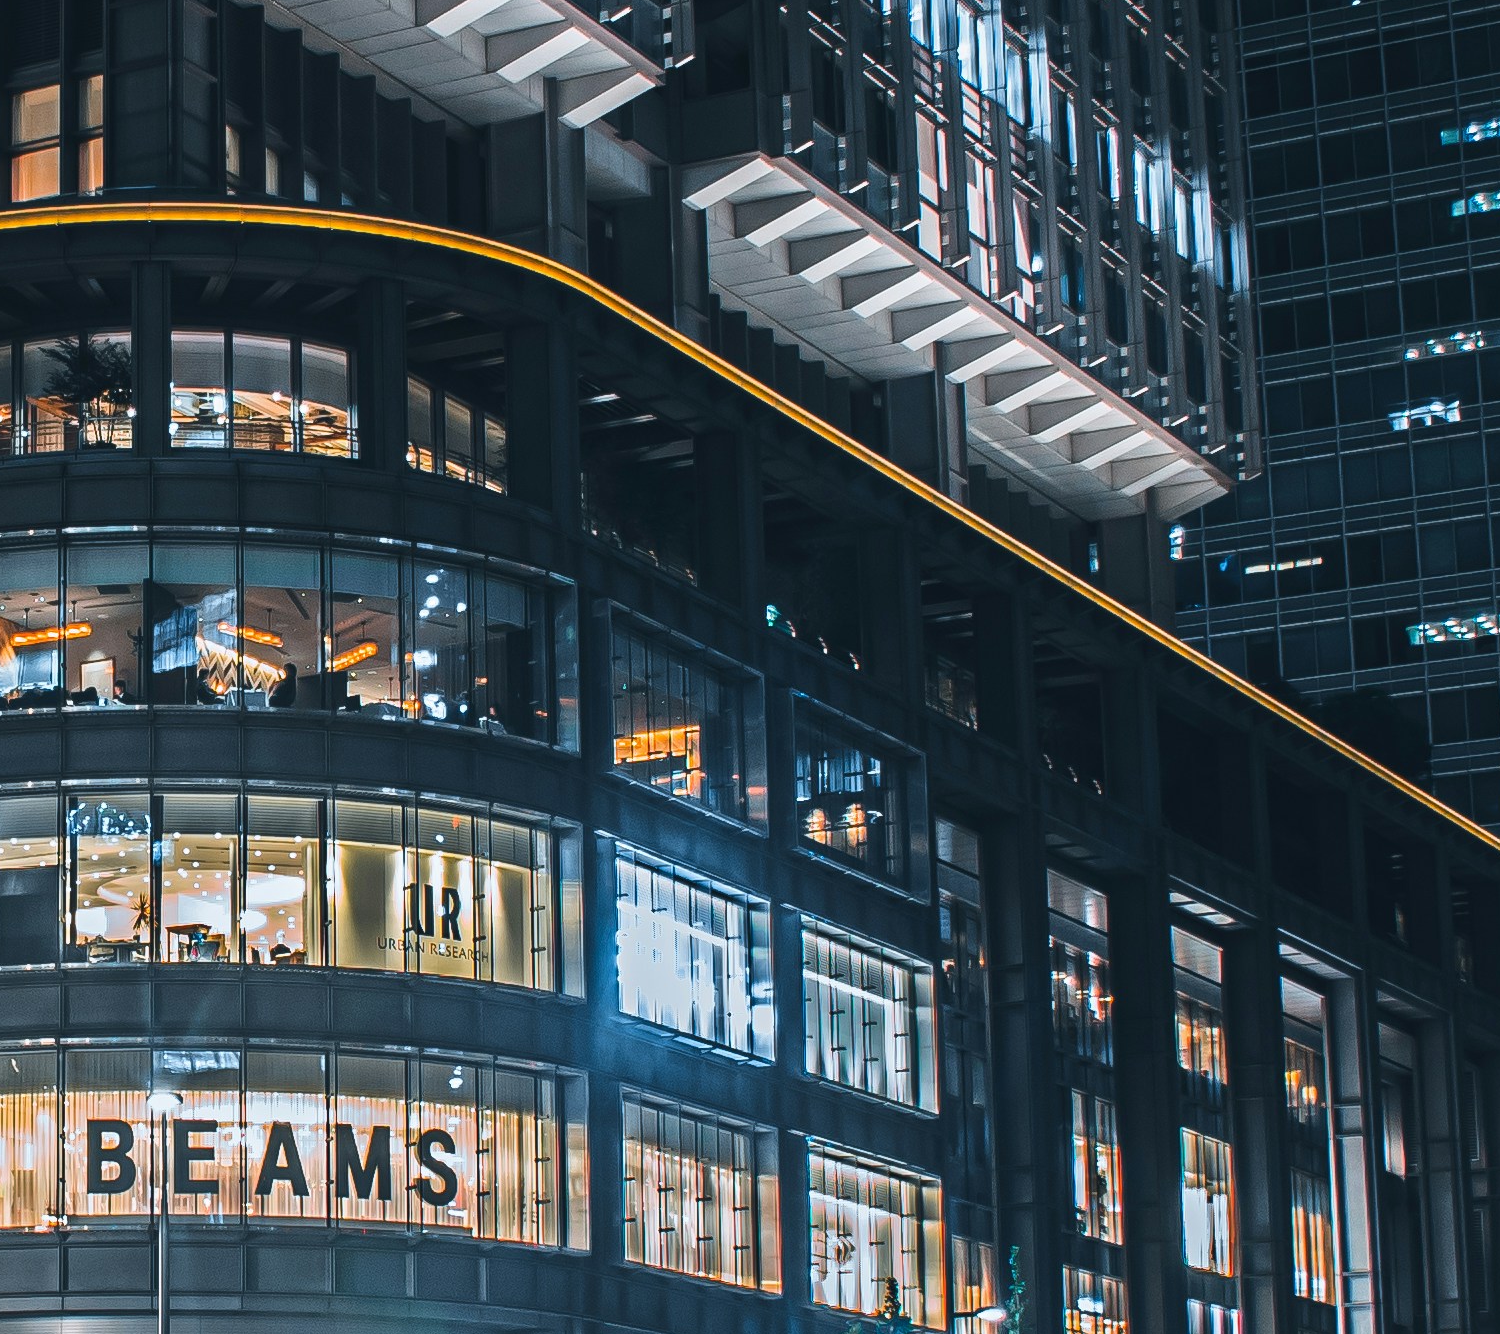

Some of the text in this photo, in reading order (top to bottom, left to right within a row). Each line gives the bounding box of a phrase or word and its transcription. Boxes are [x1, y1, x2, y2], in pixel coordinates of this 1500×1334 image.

[409, 882, 462, 942] UR
[377, 936, 425, 954] URBAN
[86, 1118, 459, 1207] BEAMS
